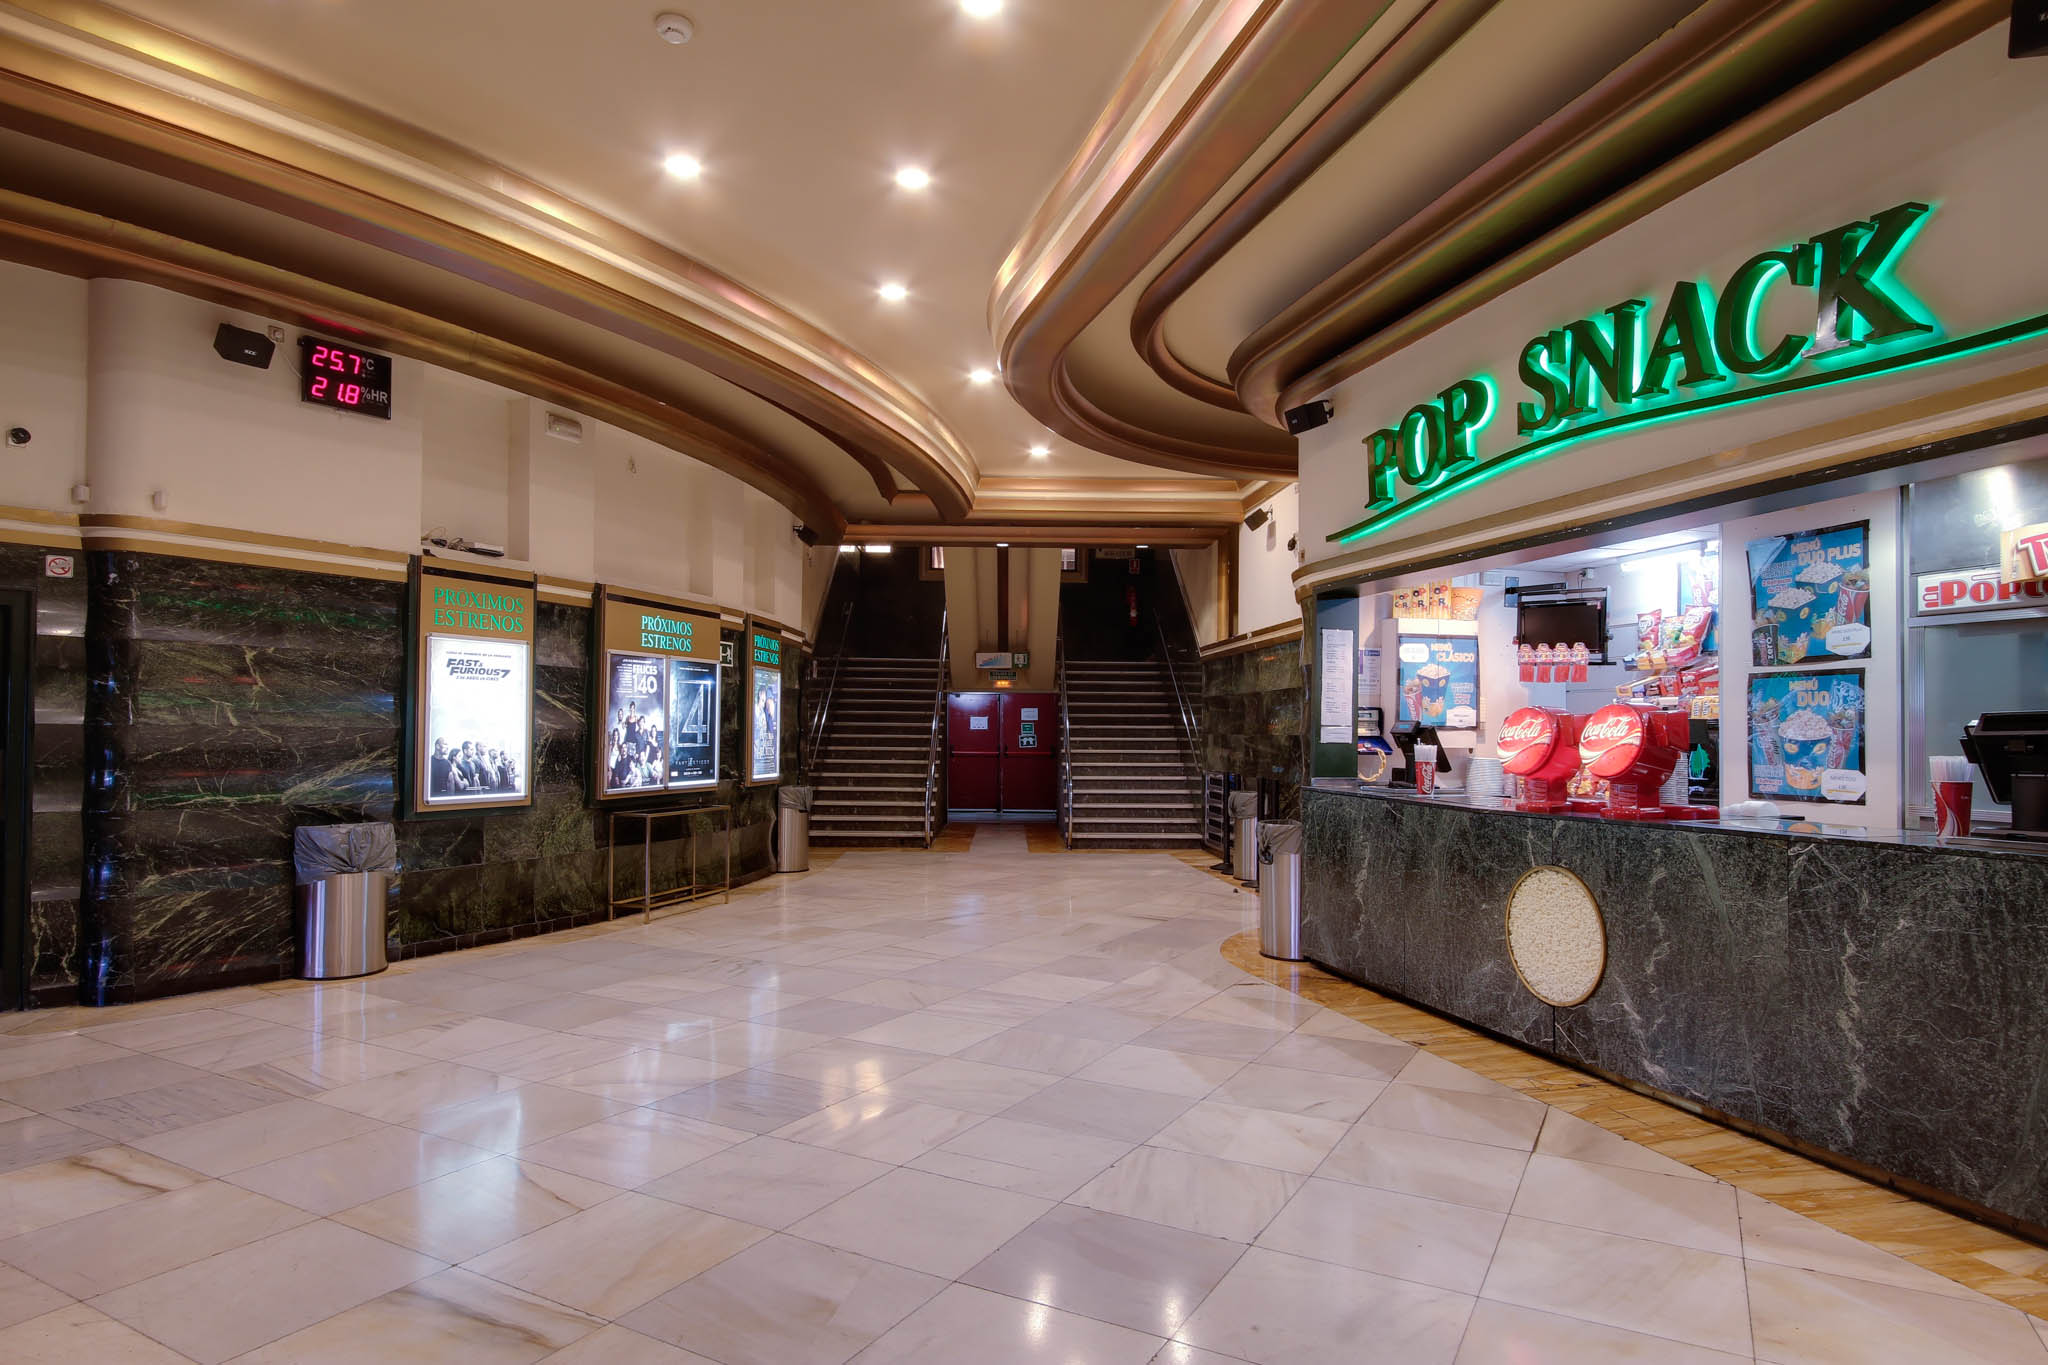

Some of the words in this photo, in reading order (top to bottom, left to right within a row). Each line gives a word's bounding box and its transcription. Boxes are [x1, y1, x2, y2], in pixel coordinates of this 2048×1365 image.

[312, 345, 360, 375] 25.7
[1362, 378, 1491, 511] POP
[1517, 202, 1936, 437] SNACK
[361, 386, 388, 404] %HR
[1790, 538, 1821, 554] MENÚ
[1798, 550, 1826, 565] DUO
[1827, 543, 1861, 561] PLUS
[2017, 530, 2048, 577] T
[434, 586, 525, 614] PRÓXIMOS
[434, 608, 525, 633] ESTRENOS
[641, 615, 693, 636] PRÓXIMOS
[641, 633, 692, 652] ESTRENOS
[446, 658, 480, 668] FAST
[1437, 650, 1475, 663] CLÁSICO
[632, 674, 658, 694] 140
[1789, 677, 1818, 691] MENÚ
[1797, 690, 1830, 707] DUO
[1498, 717, 1546, 743] Coca-Cola
[1580, 714, 1633, 744] Coca-Cola
